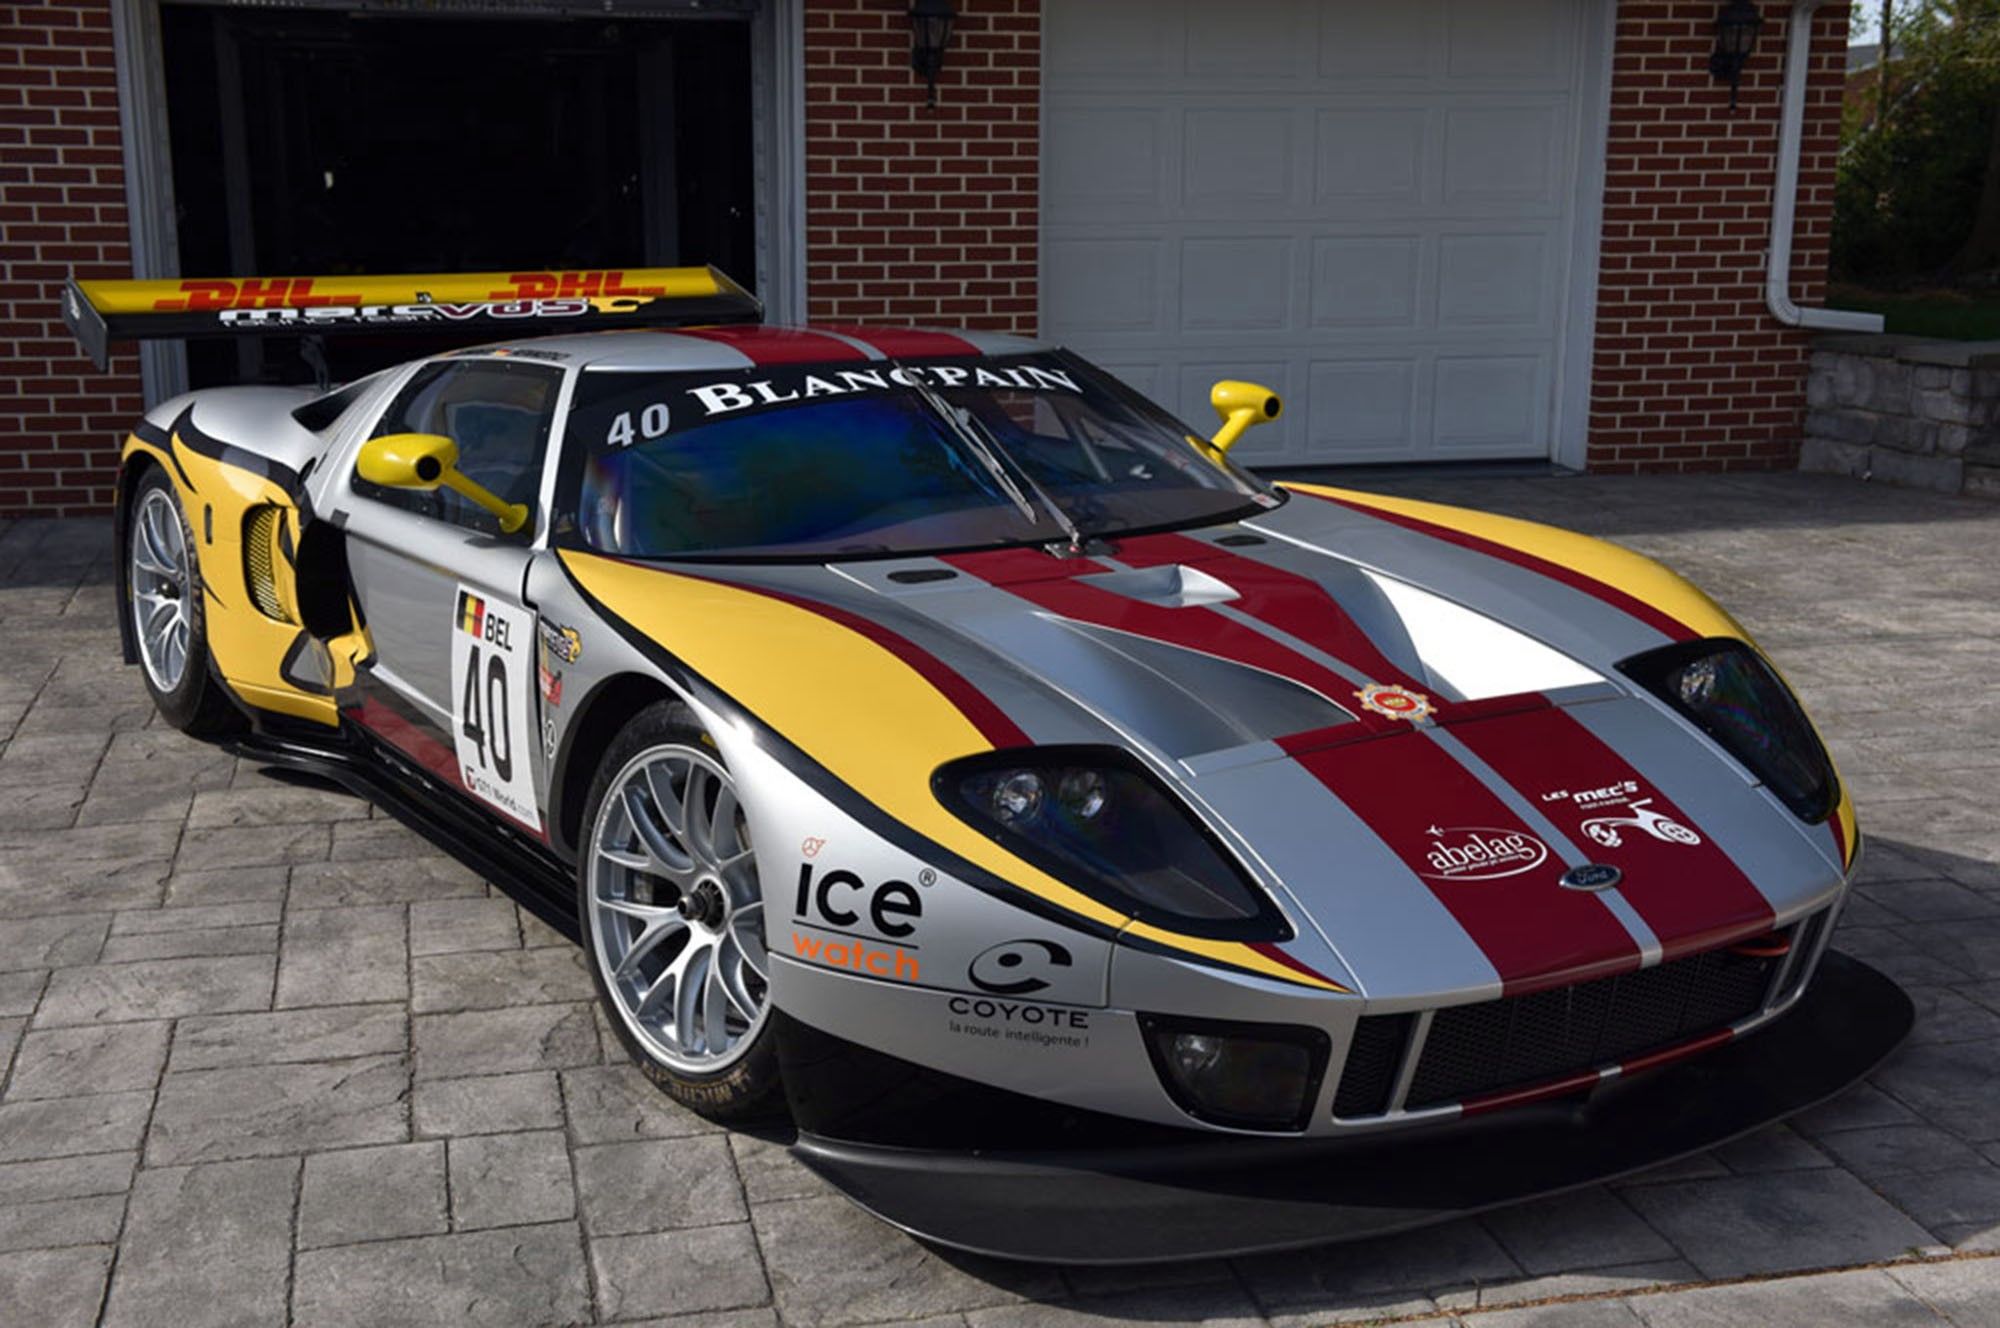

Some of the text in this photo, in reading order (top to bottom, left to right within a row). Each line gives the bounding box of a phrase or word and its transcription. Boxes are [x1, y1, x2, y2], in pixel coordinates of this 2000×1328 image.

[178, 278, 334, 310] DHL
[508, 271, 639, 300] DHL
[686, 364, 1085, 416] BLANCPAIN
[606, 402, 670, 448] 40
[485, 613, 513, 653] BEL
[463, 643, 512, 783] 40
[1542, 789, 1569, 802] LES
[1427, 833, 1536, 870] abelag
[792, 932, 921, 982] watch
[949, 996, 1090, 1030] COYOTE
[949, 1020, 961, 1033] la
[964, 1024, 1000, 1039] route
[1005, 1028, 1081, 1048] intelligente
